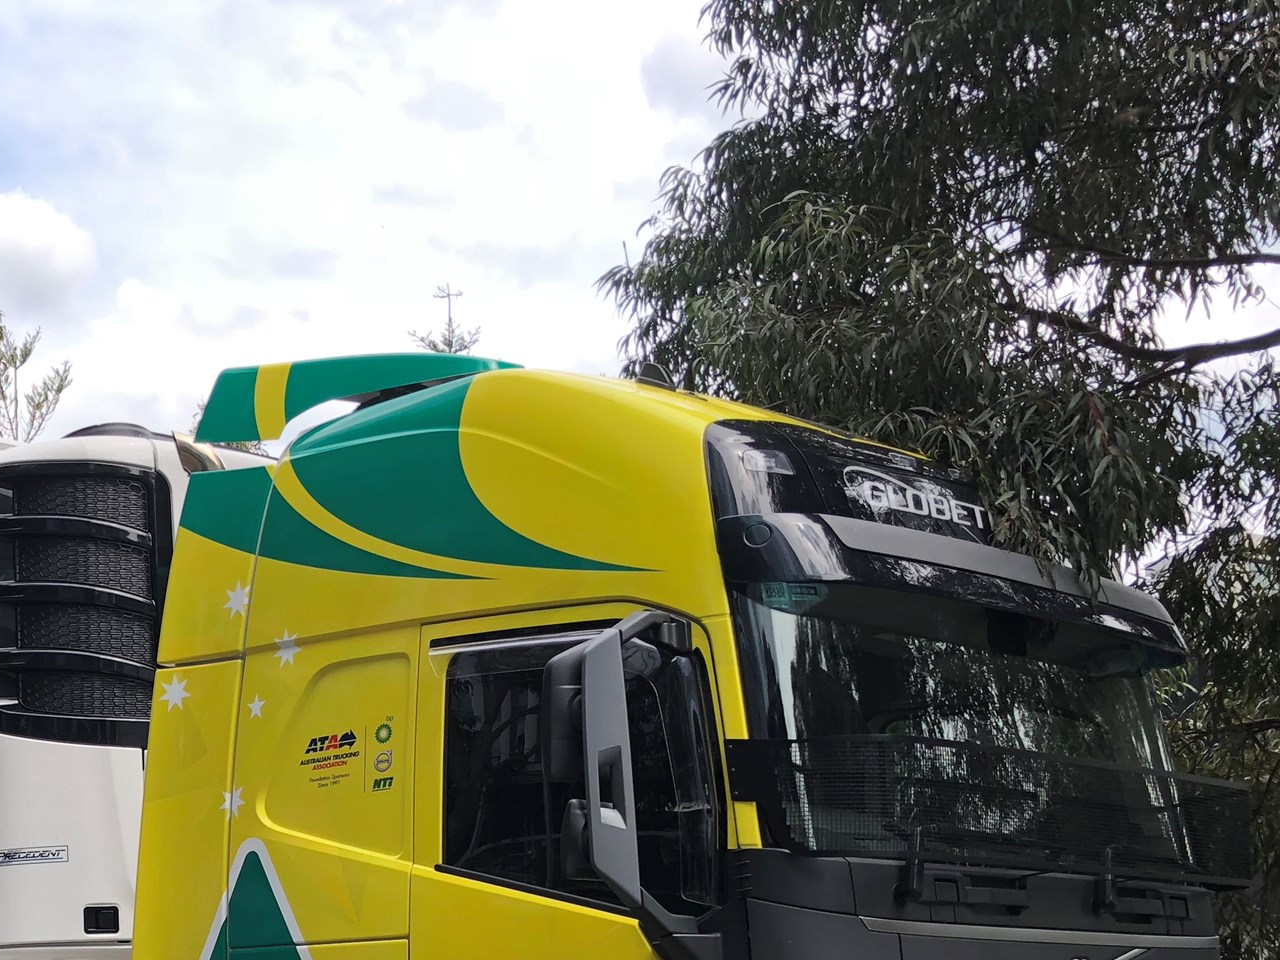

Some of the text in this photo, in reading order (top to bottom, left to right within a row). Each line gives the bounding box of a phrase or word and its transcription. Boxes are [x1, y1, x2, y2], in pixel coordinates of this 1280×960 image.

[305, 734, 338, 755] ATA
[300, 751, 360, 766] AUSTRALIAN TRUCKING
[312, 760, 348, 771] ASSOCIATION
